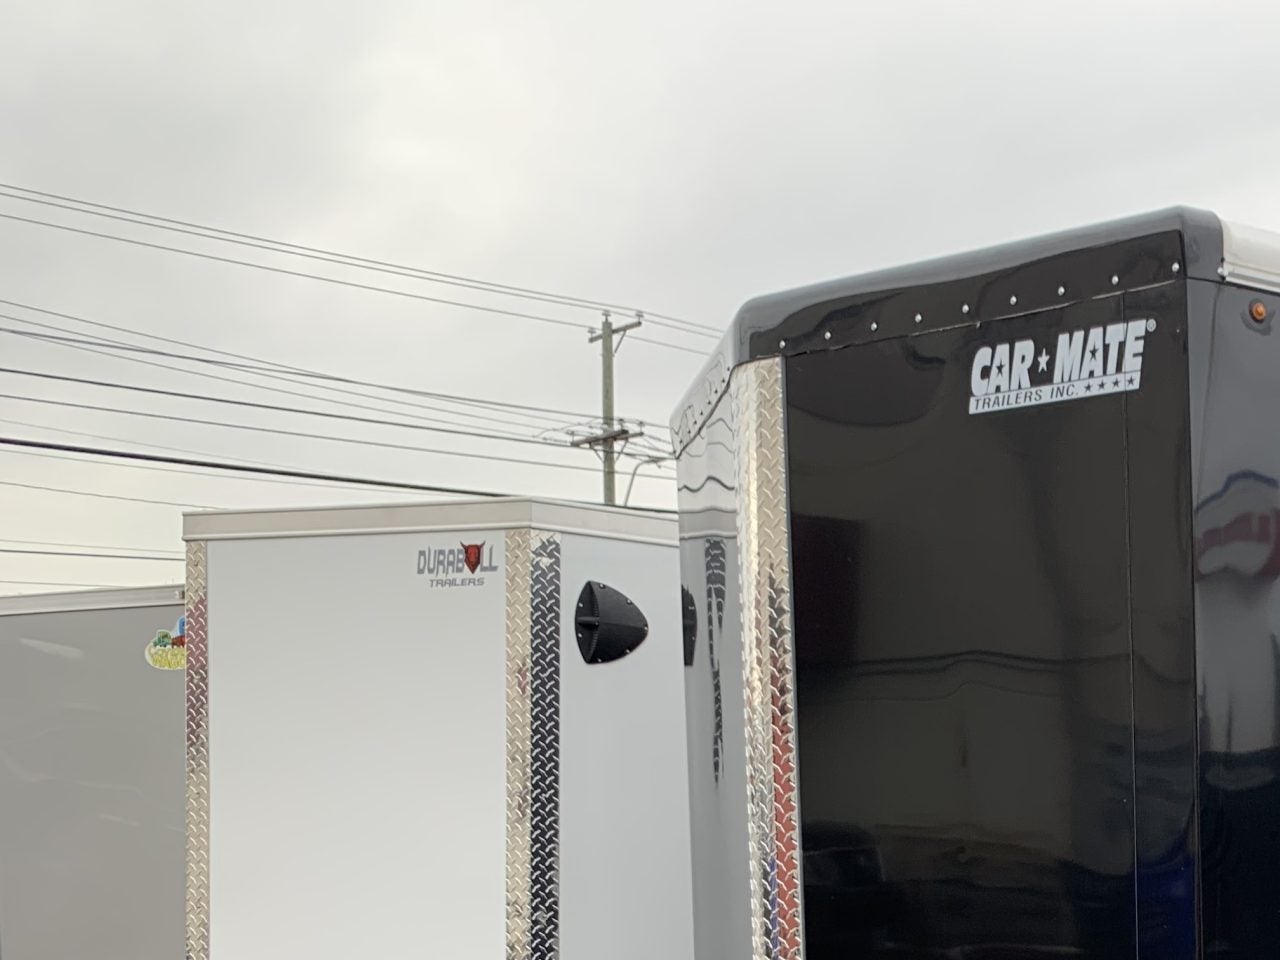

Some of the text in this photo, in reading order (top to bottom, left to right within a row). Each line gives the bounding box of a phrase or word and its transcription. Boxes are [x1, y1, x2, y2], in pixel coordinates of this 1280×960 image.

[971, 338, 1034, 397] CAR
[974, 383, 1079, 411] TRAILERS INC.
[429, 577, 485, 588] TRAILERS
